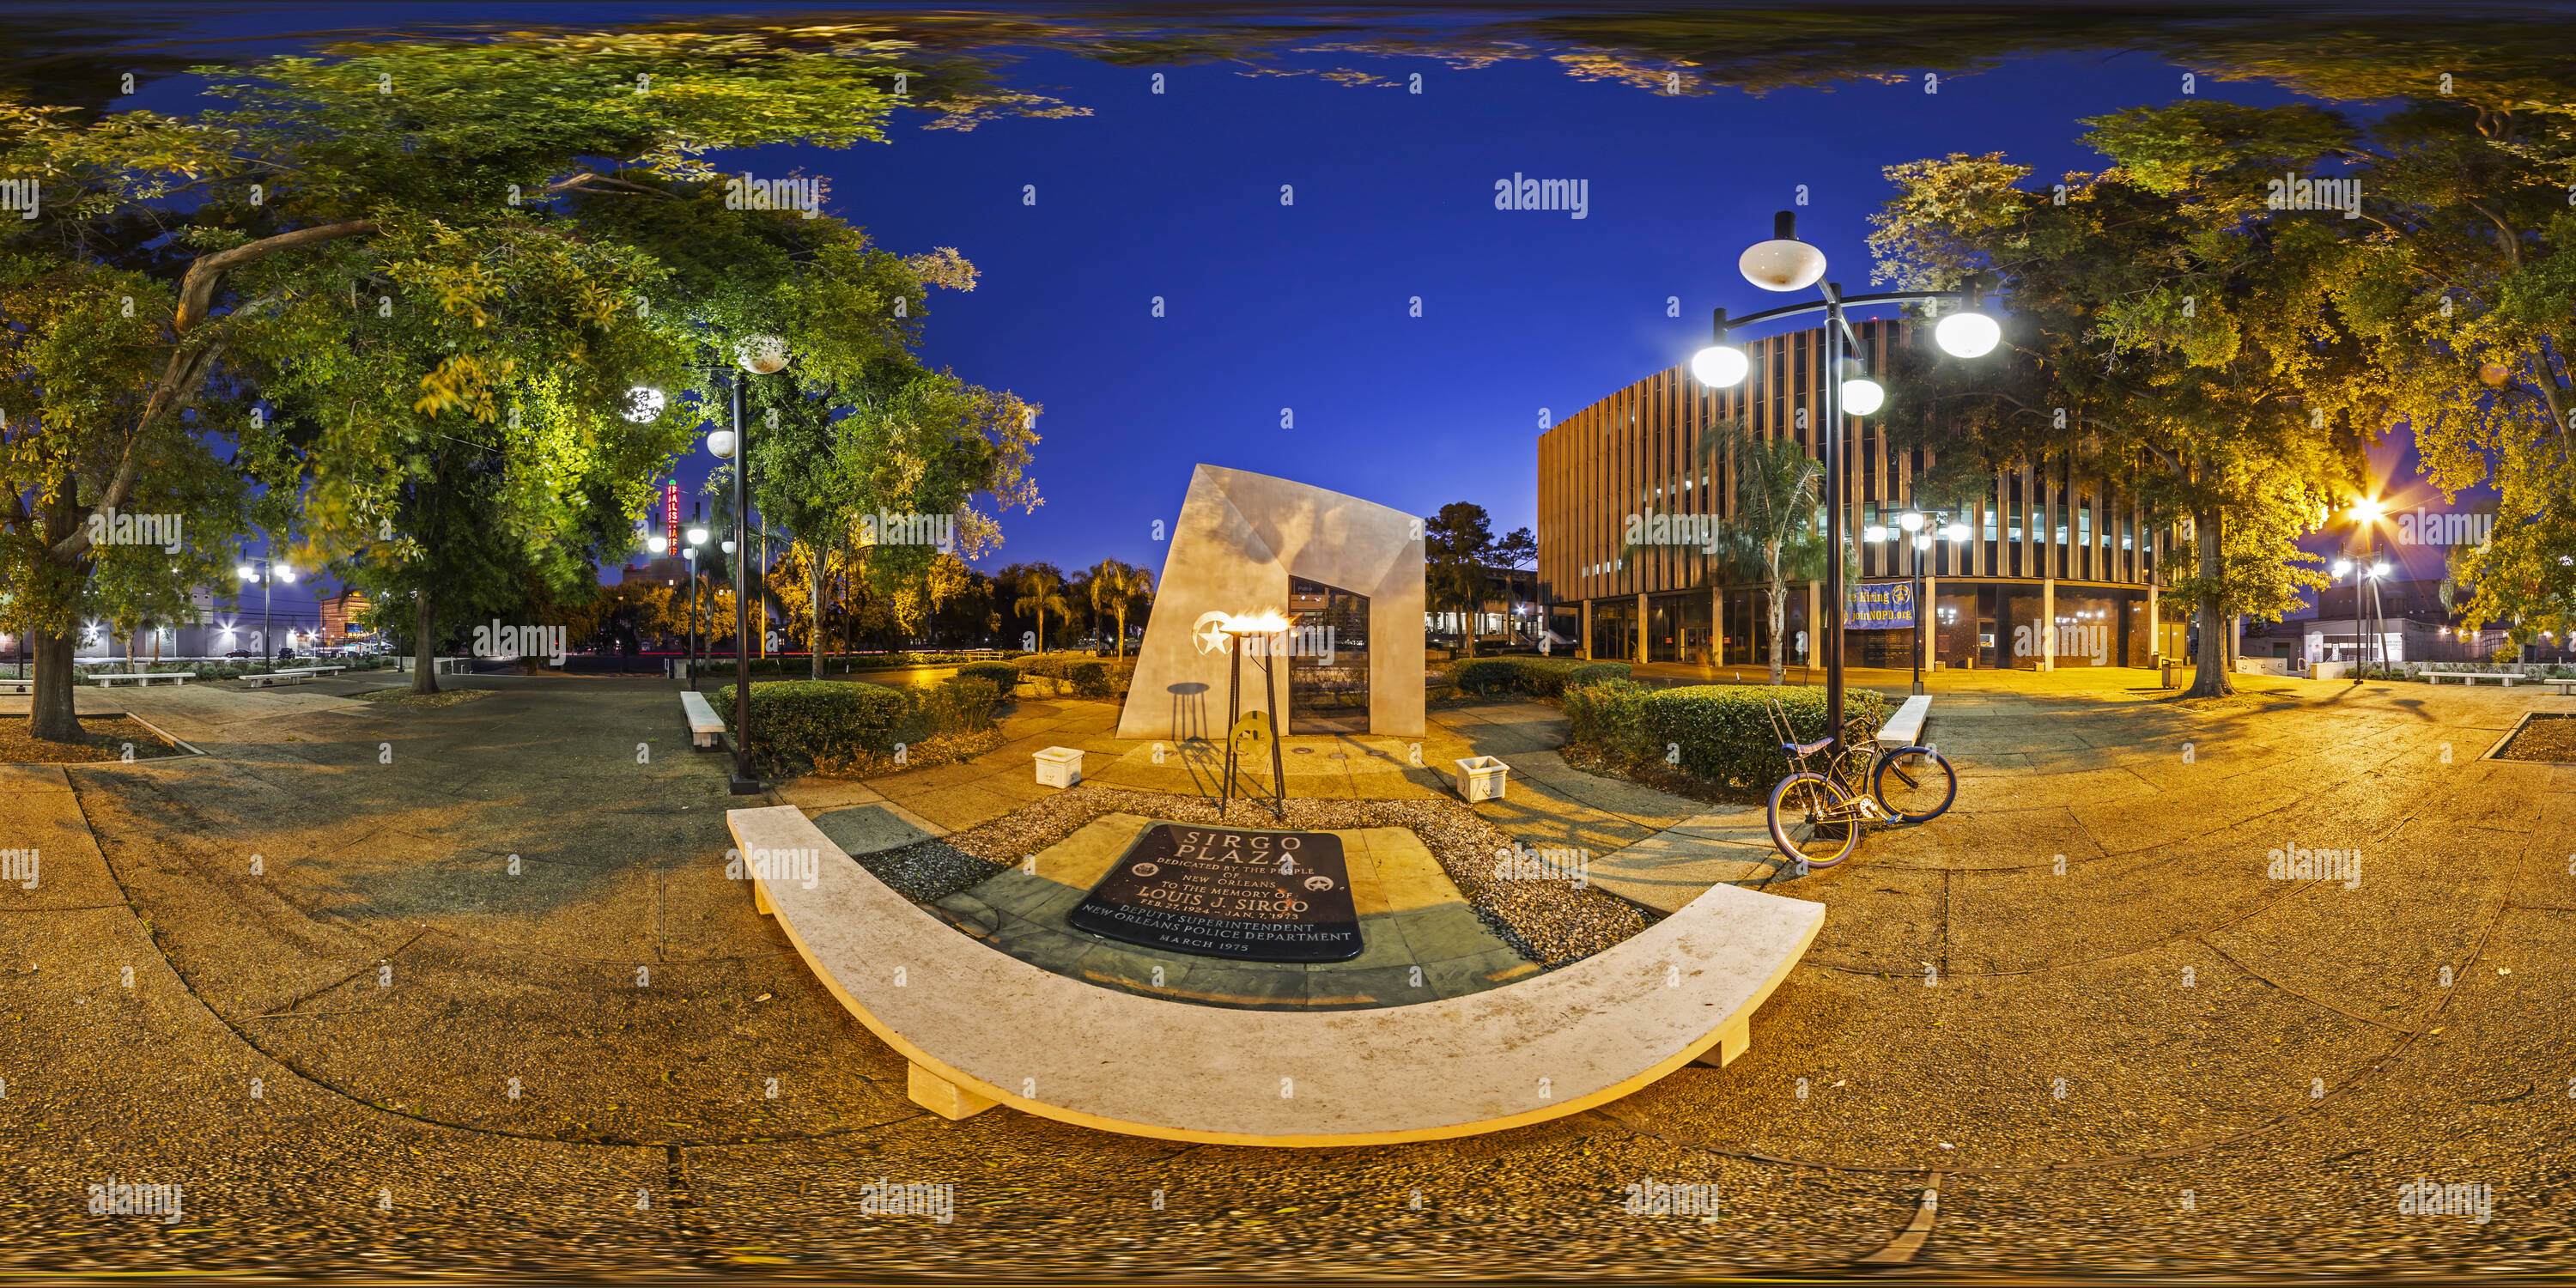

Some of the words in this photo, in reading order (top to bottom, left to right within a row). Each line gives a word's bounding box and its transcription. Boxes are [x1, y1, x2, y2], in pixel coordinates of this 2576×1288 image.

[1860, 592, 1890, 604] Hiring
[1851, 610, 1912, 623] joinNOPD.org
[1183, 831, 1301, 850] SIRGO
[1157, 857, 1220, 871] DEDICATED
[1174, 844, 1301, 866] PLAZA
[1162, 880, 1179, 890] TO
[1182, 884, 1206, 894] THE
[1210, 888, 1271, 898] MEMORY
[1182, 874, 1210, 883] NEW
[1218, 878, 1277, 889] ORLEANS
[1135, 885, 1203, 906] LOUIS
[1210, 897, 1226, 908] J.
[1235, 899, 1309, 913] SIRGO
[1140, 898, 1163, 908] FEB.
[1183, 906, 1210, 914] 1924
[1224, 910, 1255, 919] JAN.
[1082, 904, 1114, 916] NEW
[1115, 912, 1181, 932] ORLEANS
[1183, 926, 1241, 939] POLICE
[1245, 932, 1352, 941] DEPARTMENT
[1120, 904, 1176, 920] DEPUTY
[1177, 915, 1315, 932] SUPERINTENDENT
[1159, 934, 1213, 948] MARCH
[1219, 943, 1249, 951] 1975
